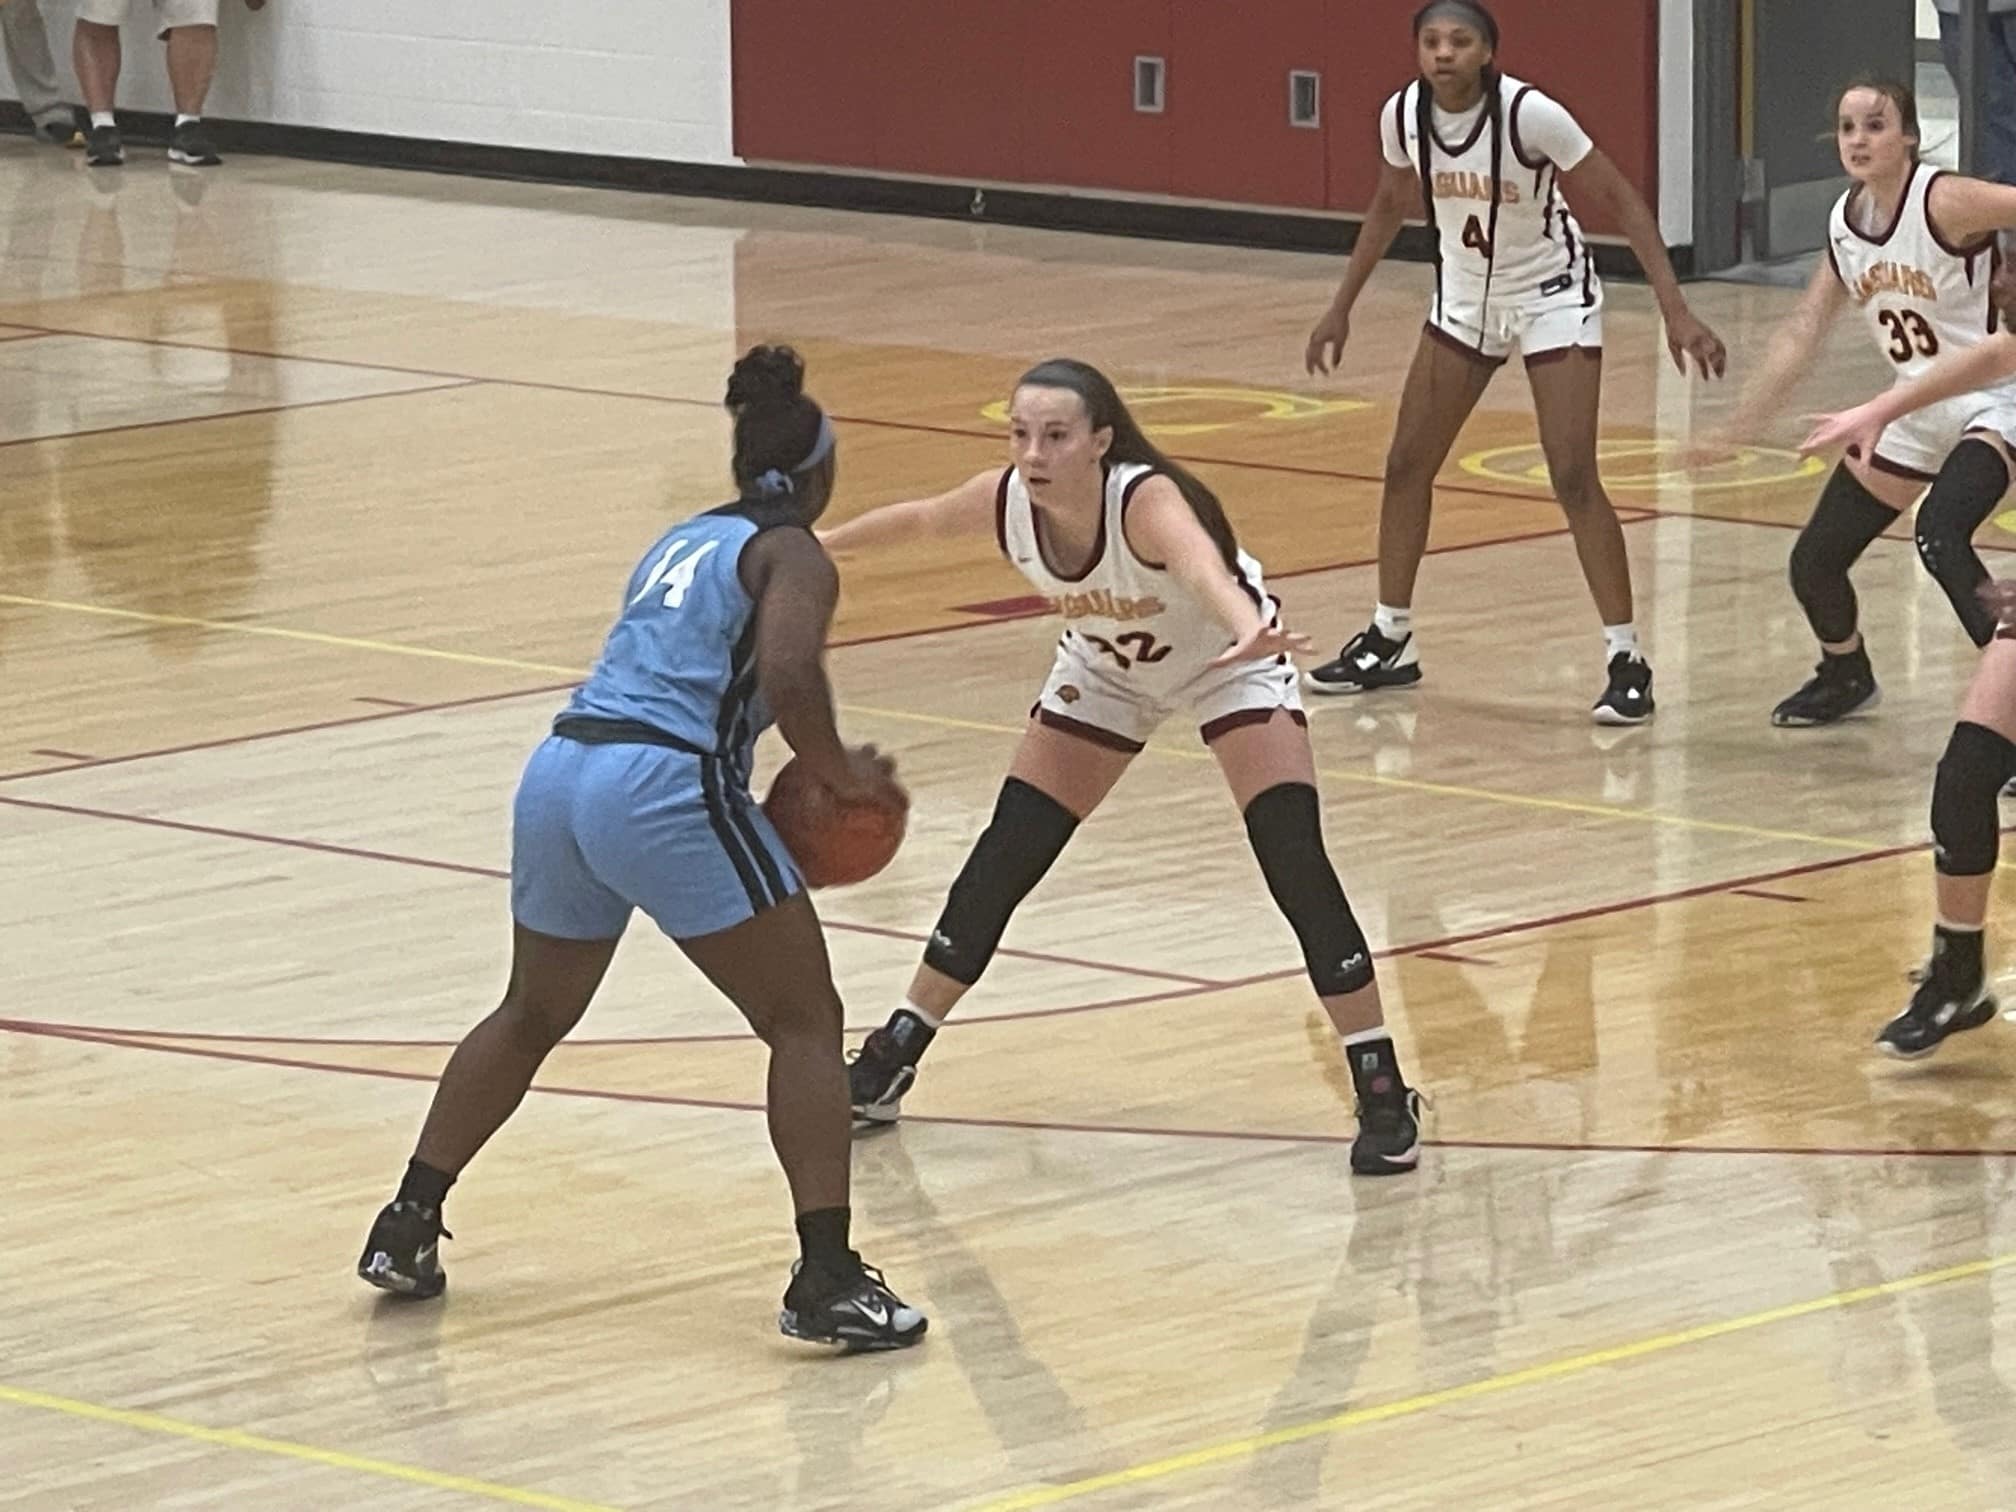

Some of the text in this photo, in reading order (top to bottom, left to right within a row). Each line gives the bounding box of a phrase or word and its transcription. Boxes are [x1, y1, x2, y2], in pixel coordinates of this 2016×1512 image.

[1462, 213, 1492, 258] 4
[1879, 308, 1939, 363] 33
[628, 538, 720, 609] 14
